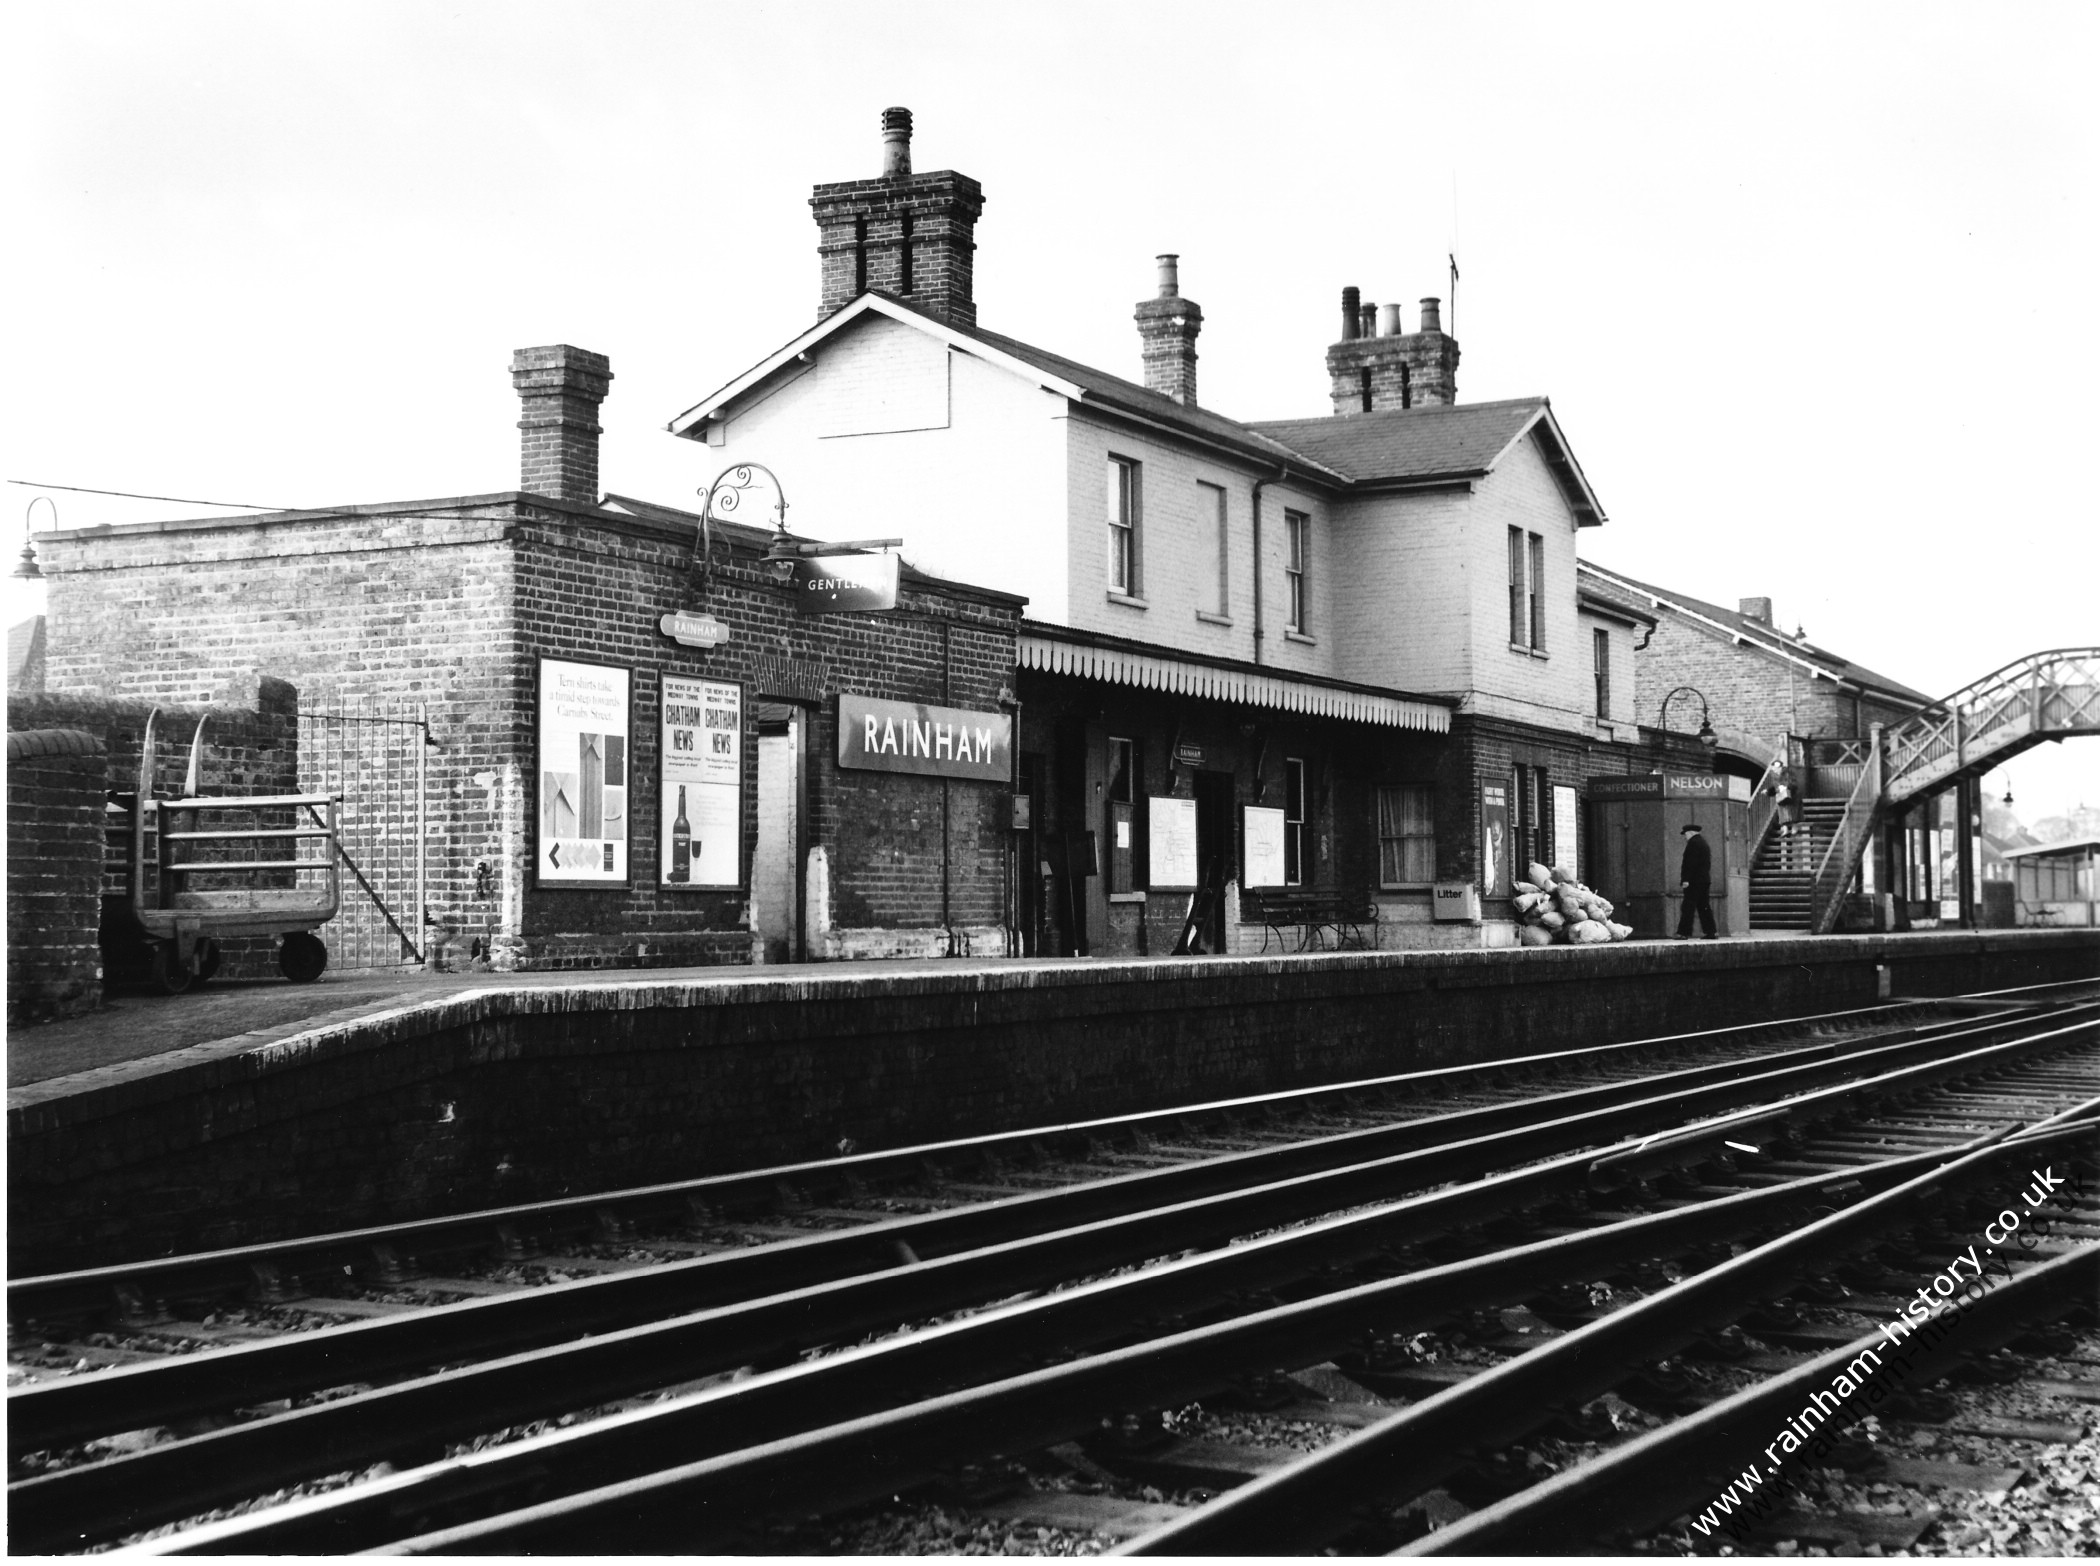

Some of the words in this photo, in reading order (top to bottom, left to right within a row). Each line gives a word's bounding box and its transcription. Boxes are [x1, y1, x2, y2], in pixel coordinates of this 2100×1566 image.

[674, 620, 717, 638] RAINHAM
[666, 703, 700, 727] CHATHAM
[706, 708, 737, 731] CHATHAM
[674, 729, 693, 751] NEWS
[713, 732, 731, 754] NEWS
[864, 714, 992, 765] RAINHAM
[1593, 782, 1658, 793] CONFECTIONER
[1670, 776, 1723, 789] NELSON
[1437, 889, 1463, 899] Litter
